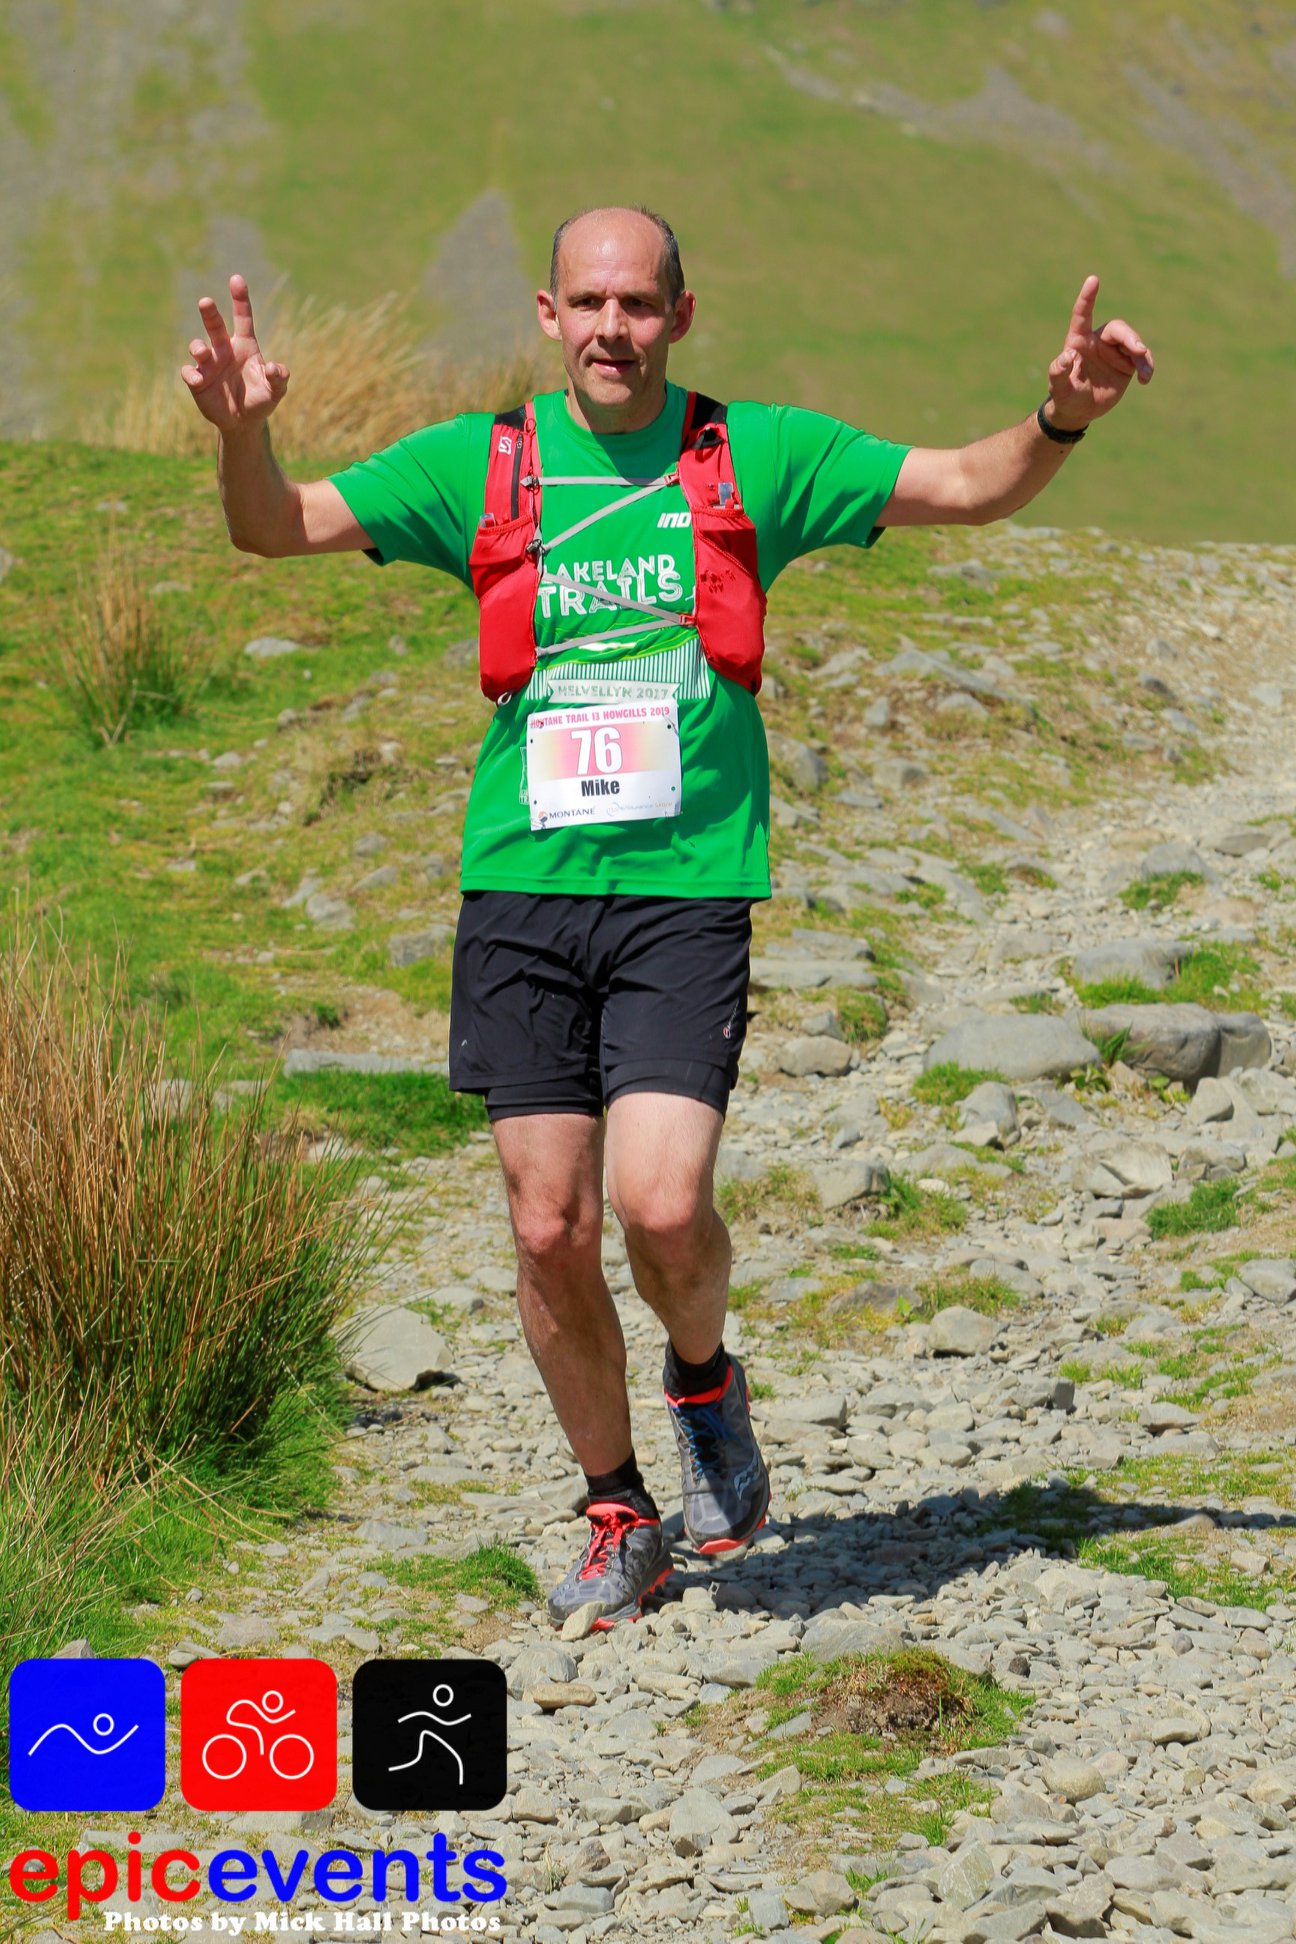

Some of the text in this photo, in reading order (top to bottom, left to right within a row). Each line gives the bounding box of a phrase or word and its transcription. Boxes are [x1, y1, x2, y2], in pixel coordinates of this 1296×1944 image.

[538, 571, 683, 618] TRAILS
[636, 687, 669, 700] 2017
[566, 713, 589, 724] TRAIL
[592, 711, 600, 721] 13
[603, 708, 647, 720] HOWGILLS
[650, 706, 670, 716] 2019
[571, 726, 623, 776] 76
[580, 778, 621, 797] Mike
[548, 807, 595, 819] MONTANE
